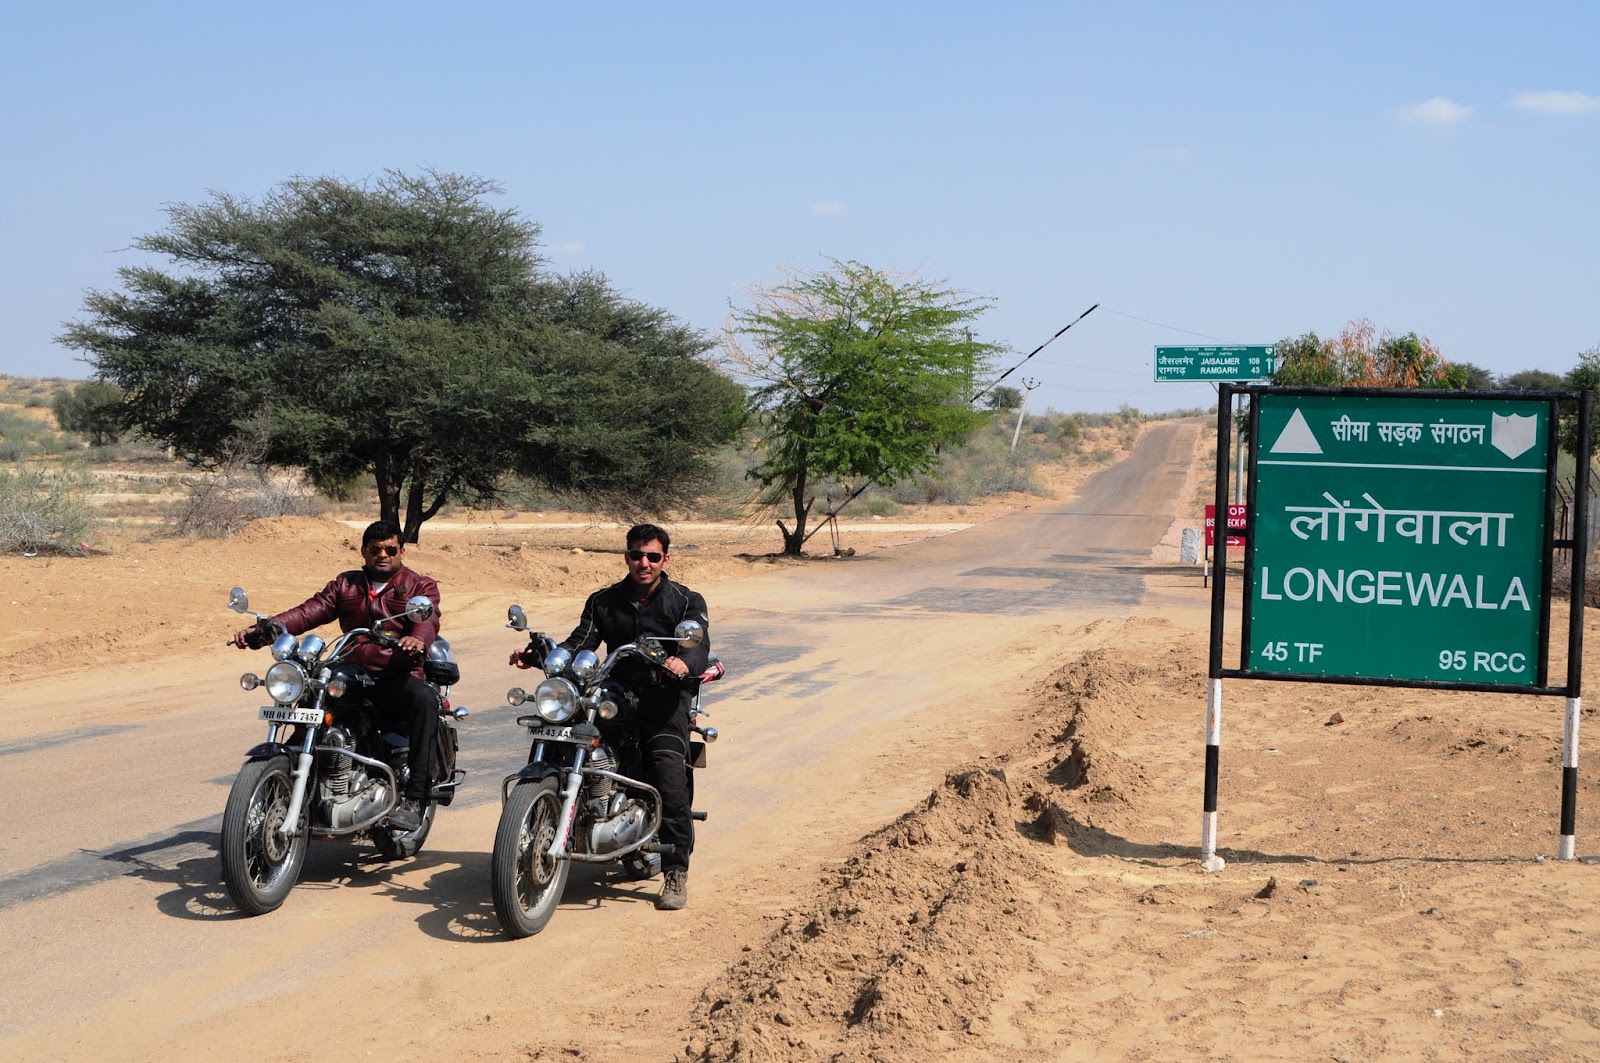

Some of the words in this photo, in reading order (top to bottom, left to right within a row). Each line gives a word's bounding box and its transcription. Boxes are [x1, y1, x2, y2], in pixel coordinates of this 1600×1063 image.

[1158, 356, 1194, 365] जैसलमेर
[1200, 357, 1240, 365] JAISALMER
[1248, 357, 1260, 365] 108
[1331, 414, 1371, 442] सीमा
[1377, 422, 1424, 447] सड़क
[1430, 418, 1486, 445] संगठन
[1285, 491, 1514, 547] लोंगेवाला
[1261, 566, 1531, 611] LONGEWALA
[1261, 641, 1288, 662] 45
[1294, 642, 1324, 663] TF
[1439, 649, 1467, 671] 95
[1473, 651, 1526, 673] RCC
[262, 710, 275, 719] MH
